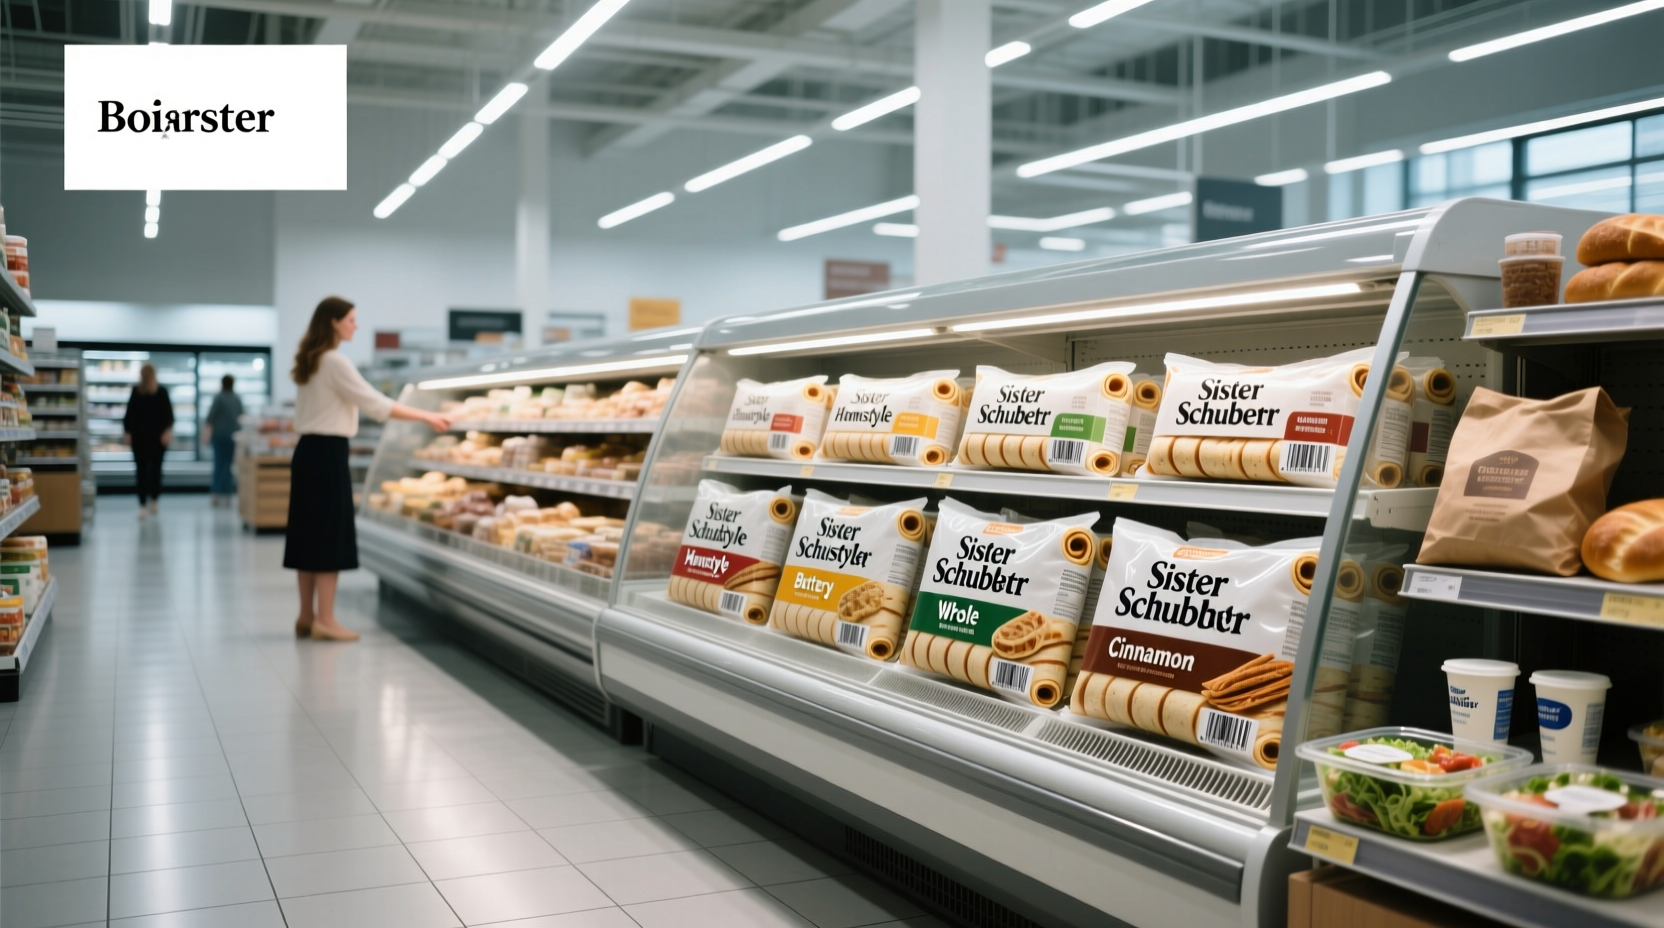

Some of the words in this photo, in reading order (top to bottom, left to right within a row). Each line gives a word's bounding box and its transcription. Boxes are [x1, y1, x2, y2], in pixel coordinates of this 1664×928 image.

[997, 384, 1046, 404] Sister
[1198, 378, 1264, 401] Sister
[816, 516, 862, 542] Sister
[956, 535, 1017, 566] Sister
[793, 571, 835, 600] Buttery
[1146, 560, 1230, 597] Sister
[938, 599, 980, 626] Whole
[1108, 636, 1195, 672] Cinnamon
